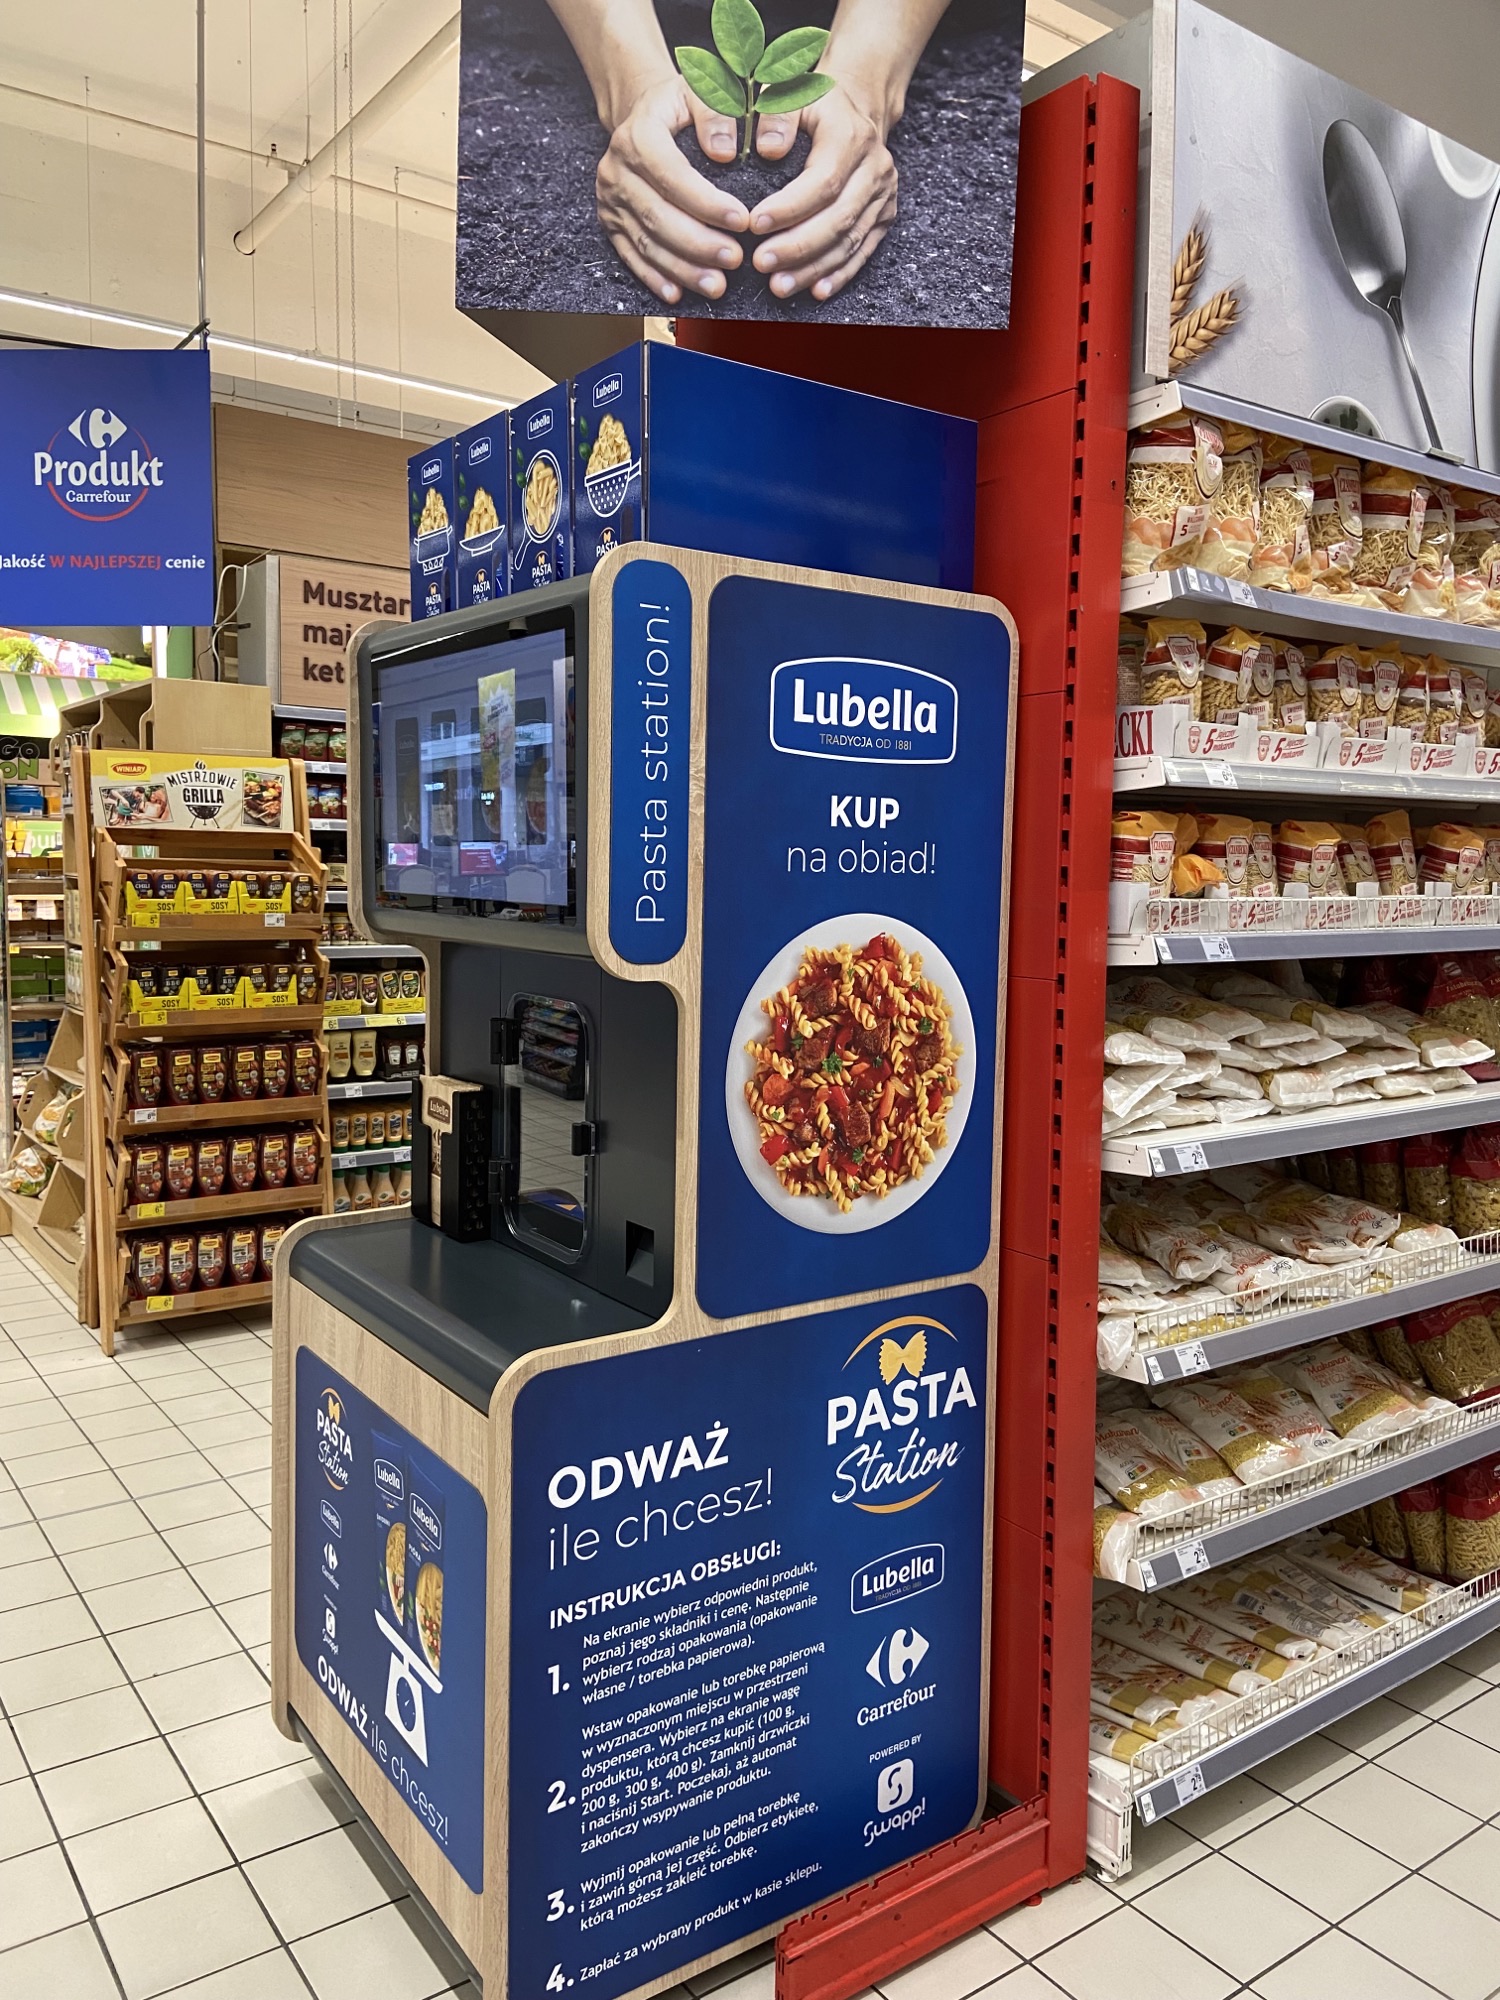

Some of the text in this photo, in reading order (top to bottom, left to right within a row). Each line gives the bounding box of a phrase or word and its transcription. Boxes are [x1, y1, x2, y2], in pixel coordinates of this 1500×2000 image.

[595, 380, 620, 400] Lubella
[529, 414, 551, 433] Lubella
[34, 450, 164, 486] Produkt
[470, 442, 489, 459] Lubella
[423, 464, 440, 479] Lubella
[65, 490, 132, 503] Carrefour
[49, 555, 65, 568] W
[70, 555, 161, 570] NAJLEPSZEJ
[165, 556, 206, 569] cenie
[531, 563, 552, 578] PASTA
[303, 580, 411, 615] Musztar
[425, 593, 442, 606] PASTA
[472, 579, 491, 594] PASTA
[303, 657, 344, 683] ket
[793, 677, 938, 734] Lubella
[819, 733, 873, 749] TRADYCJA
[875, 737, 892, 749] OD
[1203, 728, 1218, 755] 5
[116, 763, 147, 774] WINIARY
[635, 601, 670, 923] Pasta station!
[166, 771, 239, 790] MISTRZOWIE
[182, 787, 225, 804] GRILLA
[831, 795, 900, 829] KUP
[787, 840, 938, 874] na obiad!
[157, 902, 176, 911] SOSY
[210, 901, 229, 910] SOSY
[265, 902, 284, 910] SOSY
[161, 999, 181, 1008] SOSY
[216, 997, 235, 1006] SOSY
[271, 995, 289, 1003] SOSY
[429, 1100, 450, 1118] Lubella
[826, 1366, 977, 1446] PASTA
[317, 1408, 353, 1462] PASTA
[318, 1440, 349, 1485] Station
[377, 1464, 401, 1490] Lubella
[548, 1420, 729, 1509] ODWAŻ
[831, 1427, 965, 1504] Station
[322, 1504, 340, 1530] Lubella
[413, 1499, 438, 1538] Lubella
[549, 1467, 772, 1571] ile chcesz!
[550, 1539, 781, 1630] INSTRUKCJA OBSŁUGI:
[861, 1556, 935, 1597] Lubella
[583, 1561, 818, 1649] Na ekranie wybierz odpowiedni produkt,
[582, 1580, 810, 1671] poznaj jego składniki i cenę. Następnie
[582, 1594, 818, 1686] wybierz rodzaj opakowania (opakowanie
[547, 1664, 570, 1695] 1.
[582, 1633, 755, 1705] własne / torebka papierowa).
[581, 1641, 825, 1740] Wstaw opakowanie lub torebkę papierową
[856, 1683, 937, 1726] Carrefour
[581, 1662, 808, 1759] w wyznaczonym miejscu w przestrzeni
[581, 1685, 801, 1779] dyspensera. Wybierz na ekranie wagę
[869, 1733, 922, 1763] POWERED BY
[317, 1655, 449, 1846] ODWAŻ ile chcesz!
[581, 1705, 795, 1801] produktu, którą chcesz kupić (100 g,
[581, 1712, 810, 1816] 200 g, 300 g, 400 g). Zamknij drzwiczki
[547, 1780, 576, 1813] 2.
[581, 1736, 797, 1835] i naciśnij Start. Poczekaj, aż automat
[580, 1766, 772, 1853] zakończy wsypywanie produktu.
[864, 1797, 927, 1847] Swapp!
[580, 1792, 801, 1894] Wyjmij opakowanie lub pełną torebkę
[580, 1802, 819, 1913] i zawiń górną jej część. Odbierz etykietę,
[546, 1889, 575, 1922] 3.
[580, 1846, 758, 1932] którą możesz zakleić torebkę.
[545, 1862, 822, 1993] 4. Zapłać za wybrany produkt w kasie sklepu.
